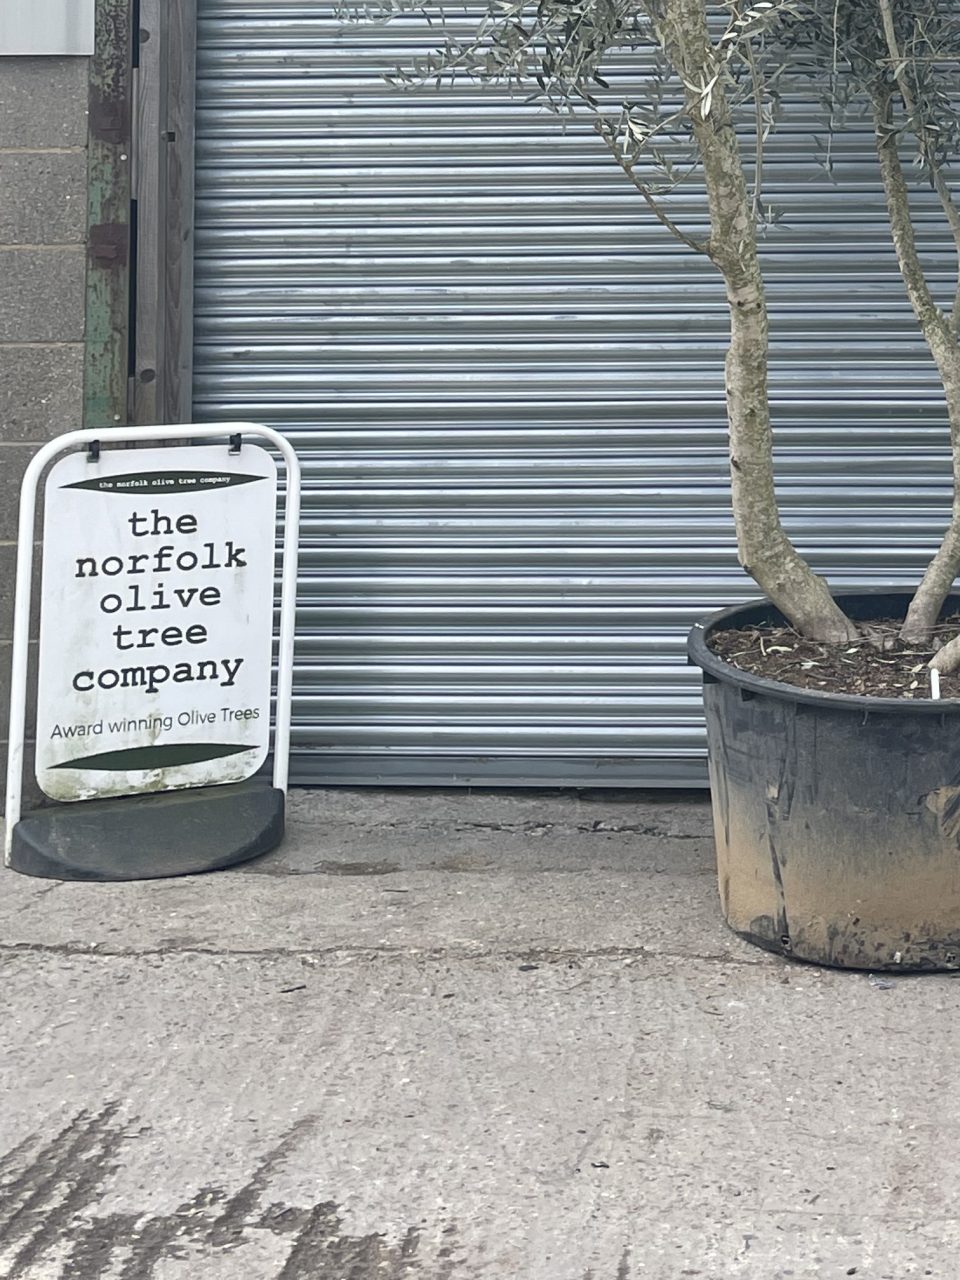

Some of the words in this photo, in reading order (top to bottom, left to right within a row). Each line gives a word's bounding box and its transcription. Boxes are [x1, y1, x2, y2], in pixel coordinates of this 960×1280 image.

[116, 479, 148, 488] norfolk
[152, 478, 174, 486] olive
[179, 477, 196, 485] tree
[200, 476, 231, 484] company
[128, 509, 198, 536] the
[75, 541, 247, 578] norfolk
[100, 583, 221, 613] olive
[113, 624, 208, 650] tree
[72, 658, 244, 693] company
[50, 720, 103, 739] Award
[108, 714, 173, 734] winning
[177, 710, 216, 727] Olive
[220, 706, 260, 722] Trees
